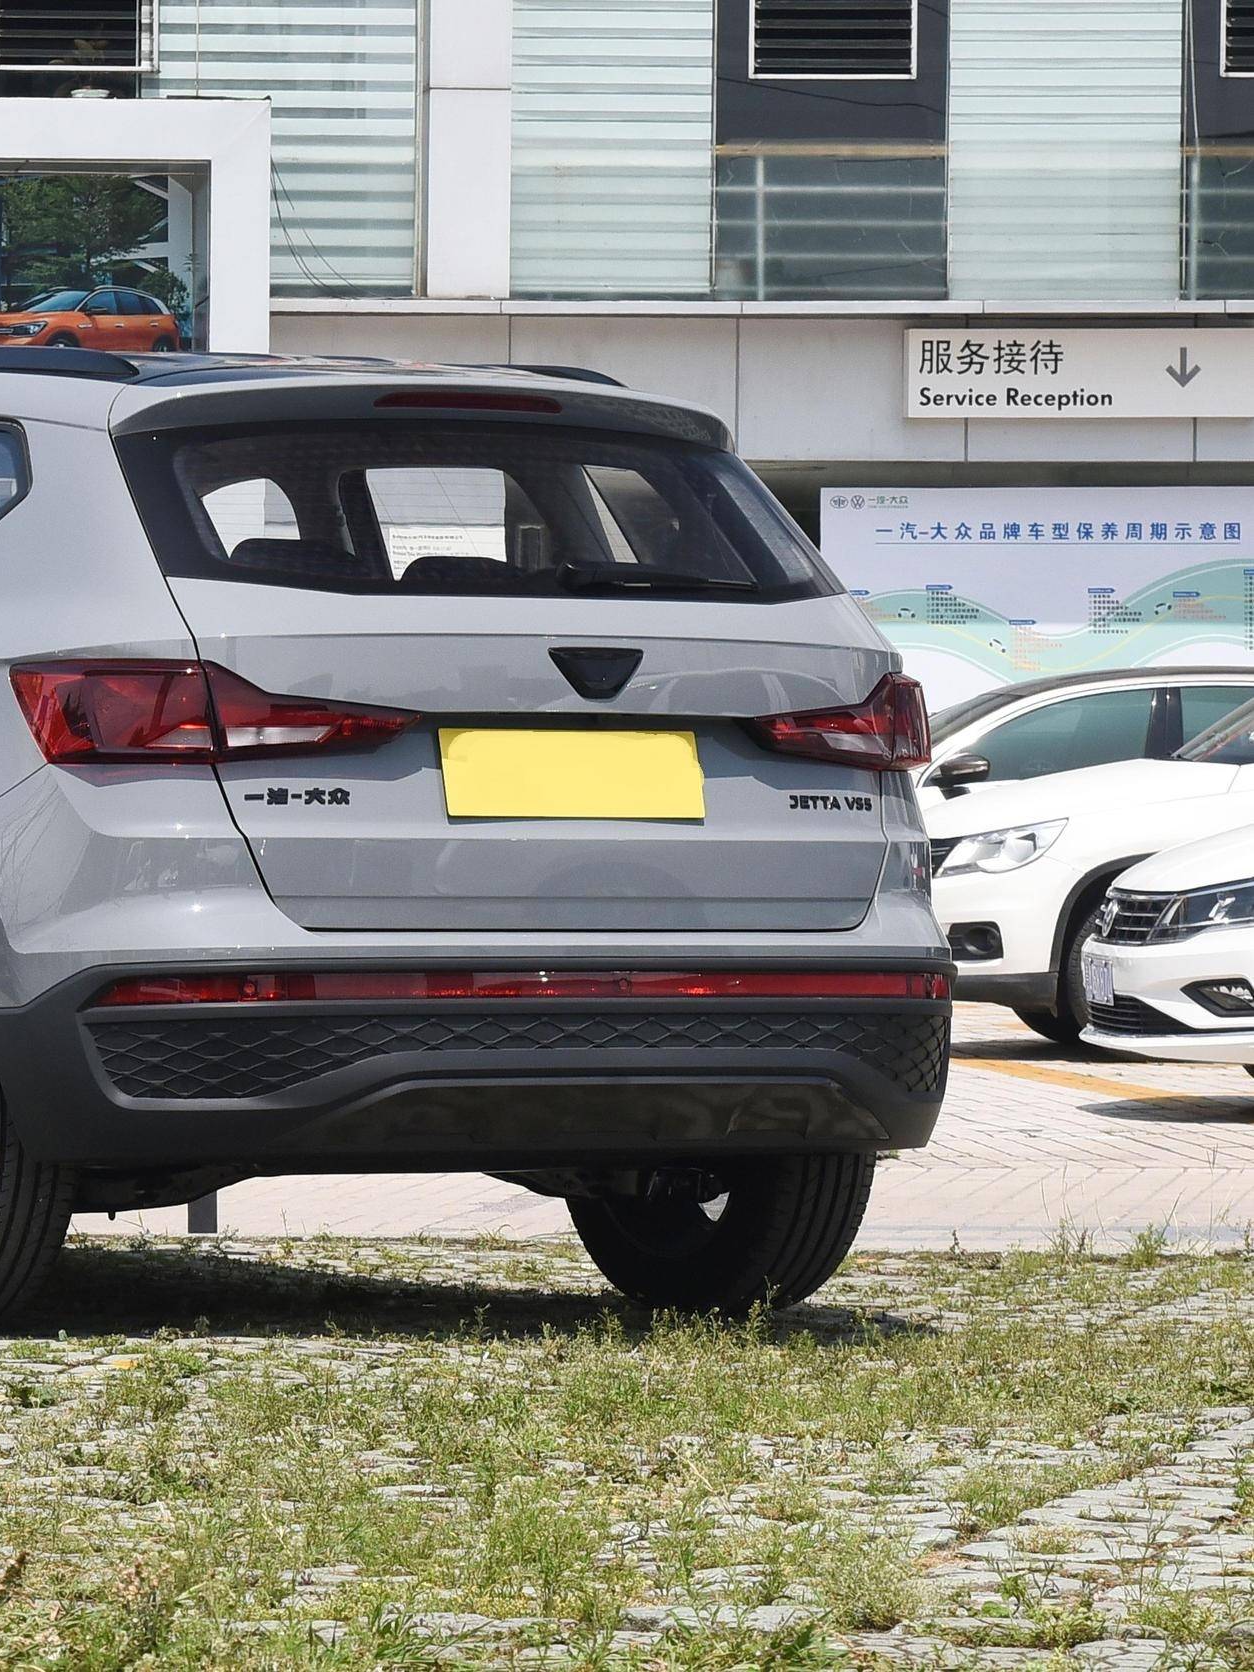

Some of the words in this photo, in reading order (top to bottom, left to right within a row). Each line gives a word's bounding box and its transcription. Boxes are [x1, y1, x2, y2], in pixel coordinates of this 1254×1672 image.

[919, 339, 1064, 376] 服务接待
[919, 387, 997, 407] Service
[1006, 387, 1113, 411] Reception
[875, 522, 1241, 541] 一汽-大众品牌车型保养周期示意图
[789, 795, 841, 810] JETTA
